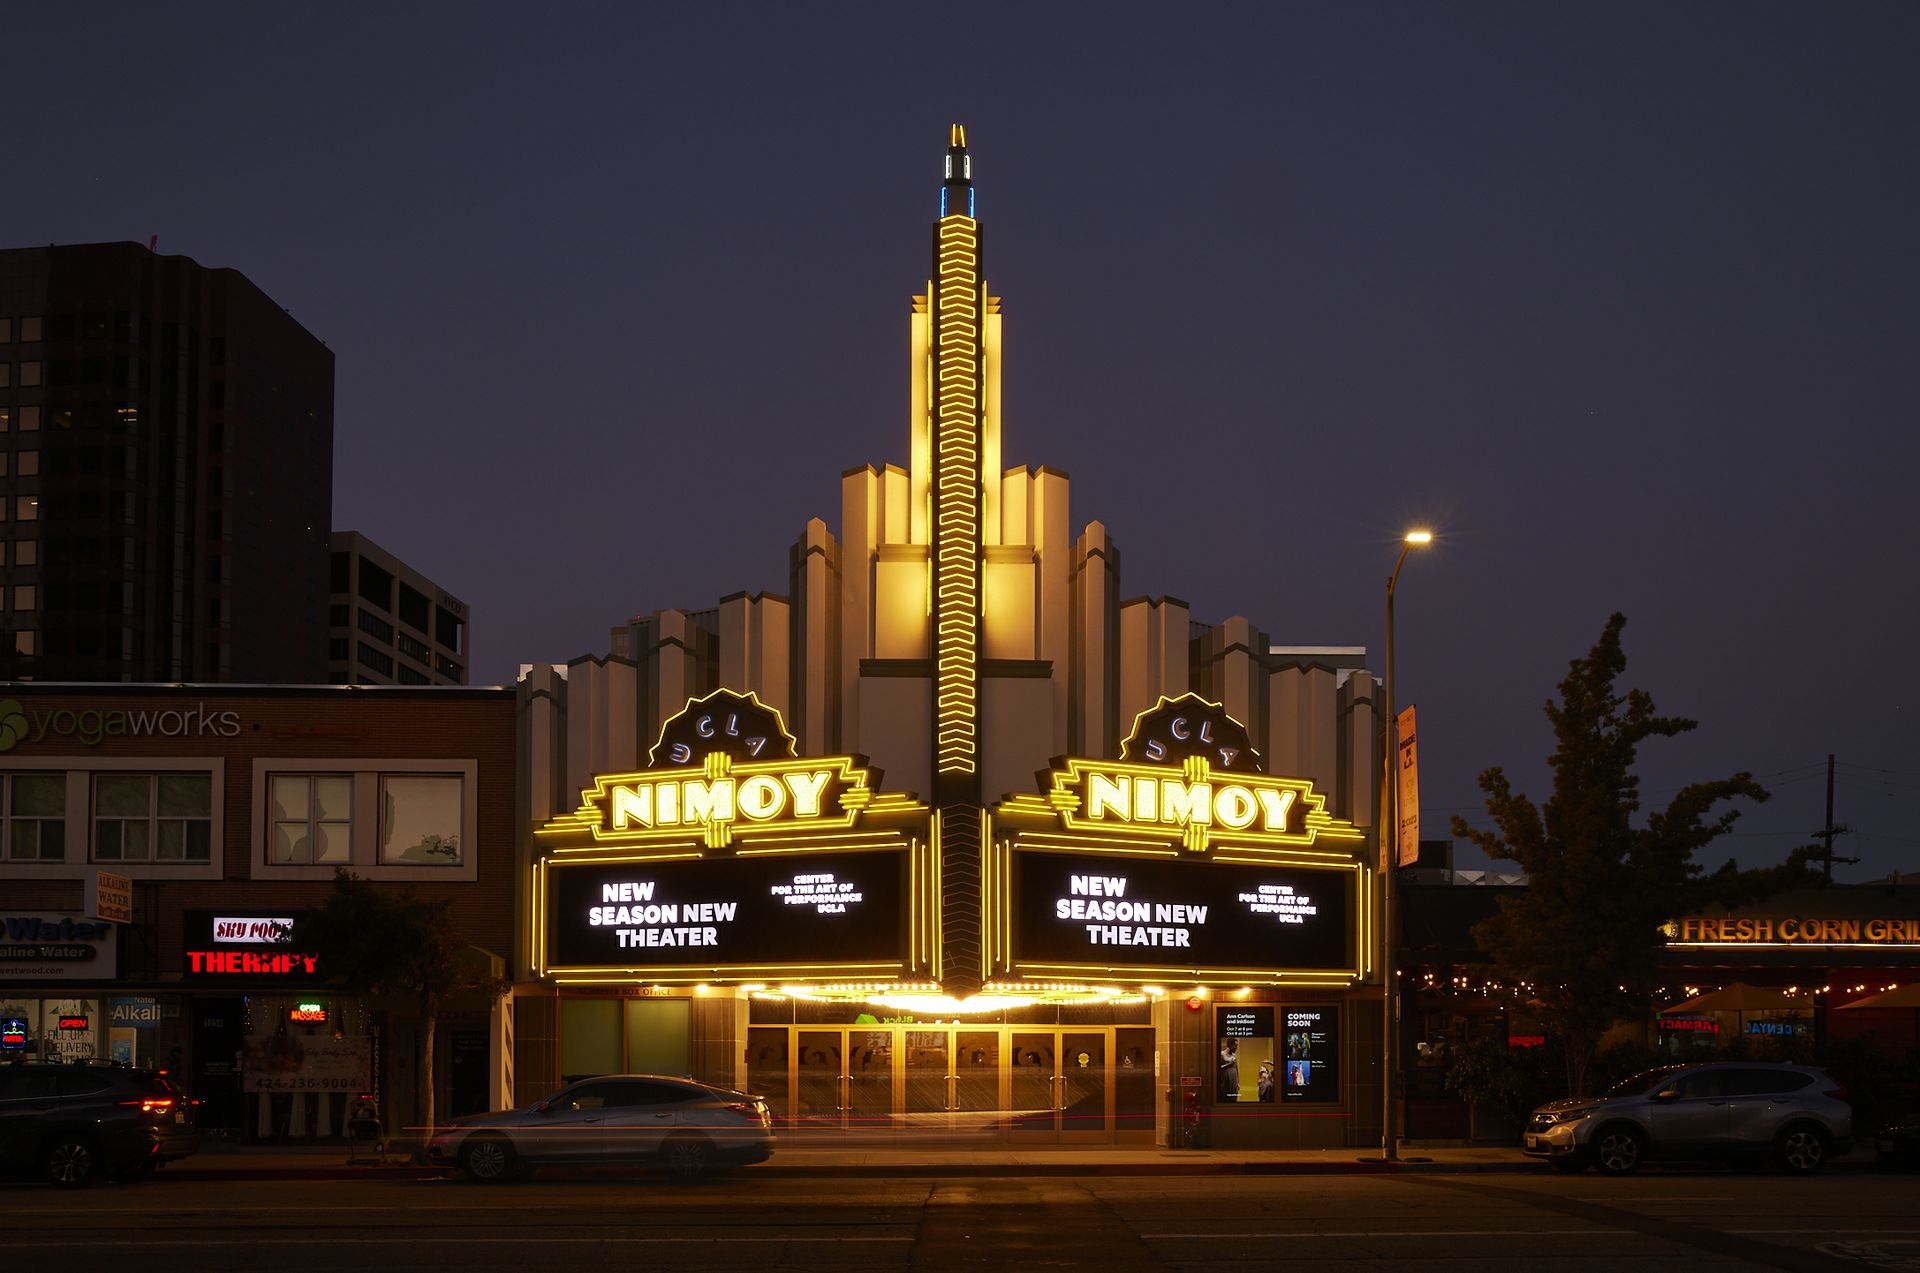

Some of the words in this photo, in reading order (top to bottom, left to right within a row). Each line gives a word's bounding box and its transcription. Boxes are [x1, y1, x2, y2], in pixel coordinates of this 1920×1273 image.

[31, 701, 241, 746] yogaworks
[671, 714, 766, 763] UCLA
[1146, 718, 1239, 766] UCLA
[612, 770, 832, 829] NIMOY
[1088, 772, 1297, 832] NIMOY
[793, 874, 834, 884] CENTER
[1070, 875, 1127, 897] NEW
[602, 881, 655, 902] NEW
[771, 885, 792, 895] FOR
[793, 885, 815, 894] THE
[816, 884, 838, 893] ART
[839, 883, 854, 893] OF
[1258, 885, 1294, 895] CENTER
[98, 890, 129, 908] WATER
[784, 893, 863, 904] PERFORMANCE
[1238, 893, 1258, 902] FOR
[1258, 894, 1277, 903] THE
[1277, 895, 1296, 904] ART
[1296, 896, 1310, 905] OF
[589, 905, 678, 925] SEASON
[683, 902, 738, 922] NEW
[817, 904, 846, 913] UCLA
[1056, 899, 1151, 922] SEASON
[1155, 904, 1208, 924] NEW
[1250, 903, 1317, 915] PERFORMANCE
[1279, 914, 1303, 924] UCLA
[6, 917, 111, 941] Water
[217, 922, 247, 938] SKY
[249, 922, 291, 938] FOO
[615, 926, 718, 947] THEATER
[1086, 925, 1191, 947] THEATER
[1682, 919, 1773, 941] FRESH
[1778, 918, 1861, 941] CORN
[41, 946, 86, 958] Water
[187, 951, 319, 973] THERAPY
[622, 988, 640, 996] BOX
[113, 1004, 161, 1021] Alkali
[291, 1010, 326, 1020] MASSAGE
[299, 1004, 320, 1012] OPEN
[59, 1020, 87, 1028] OPEN
[255, 1078, 357, 1089] 424-236-9004
